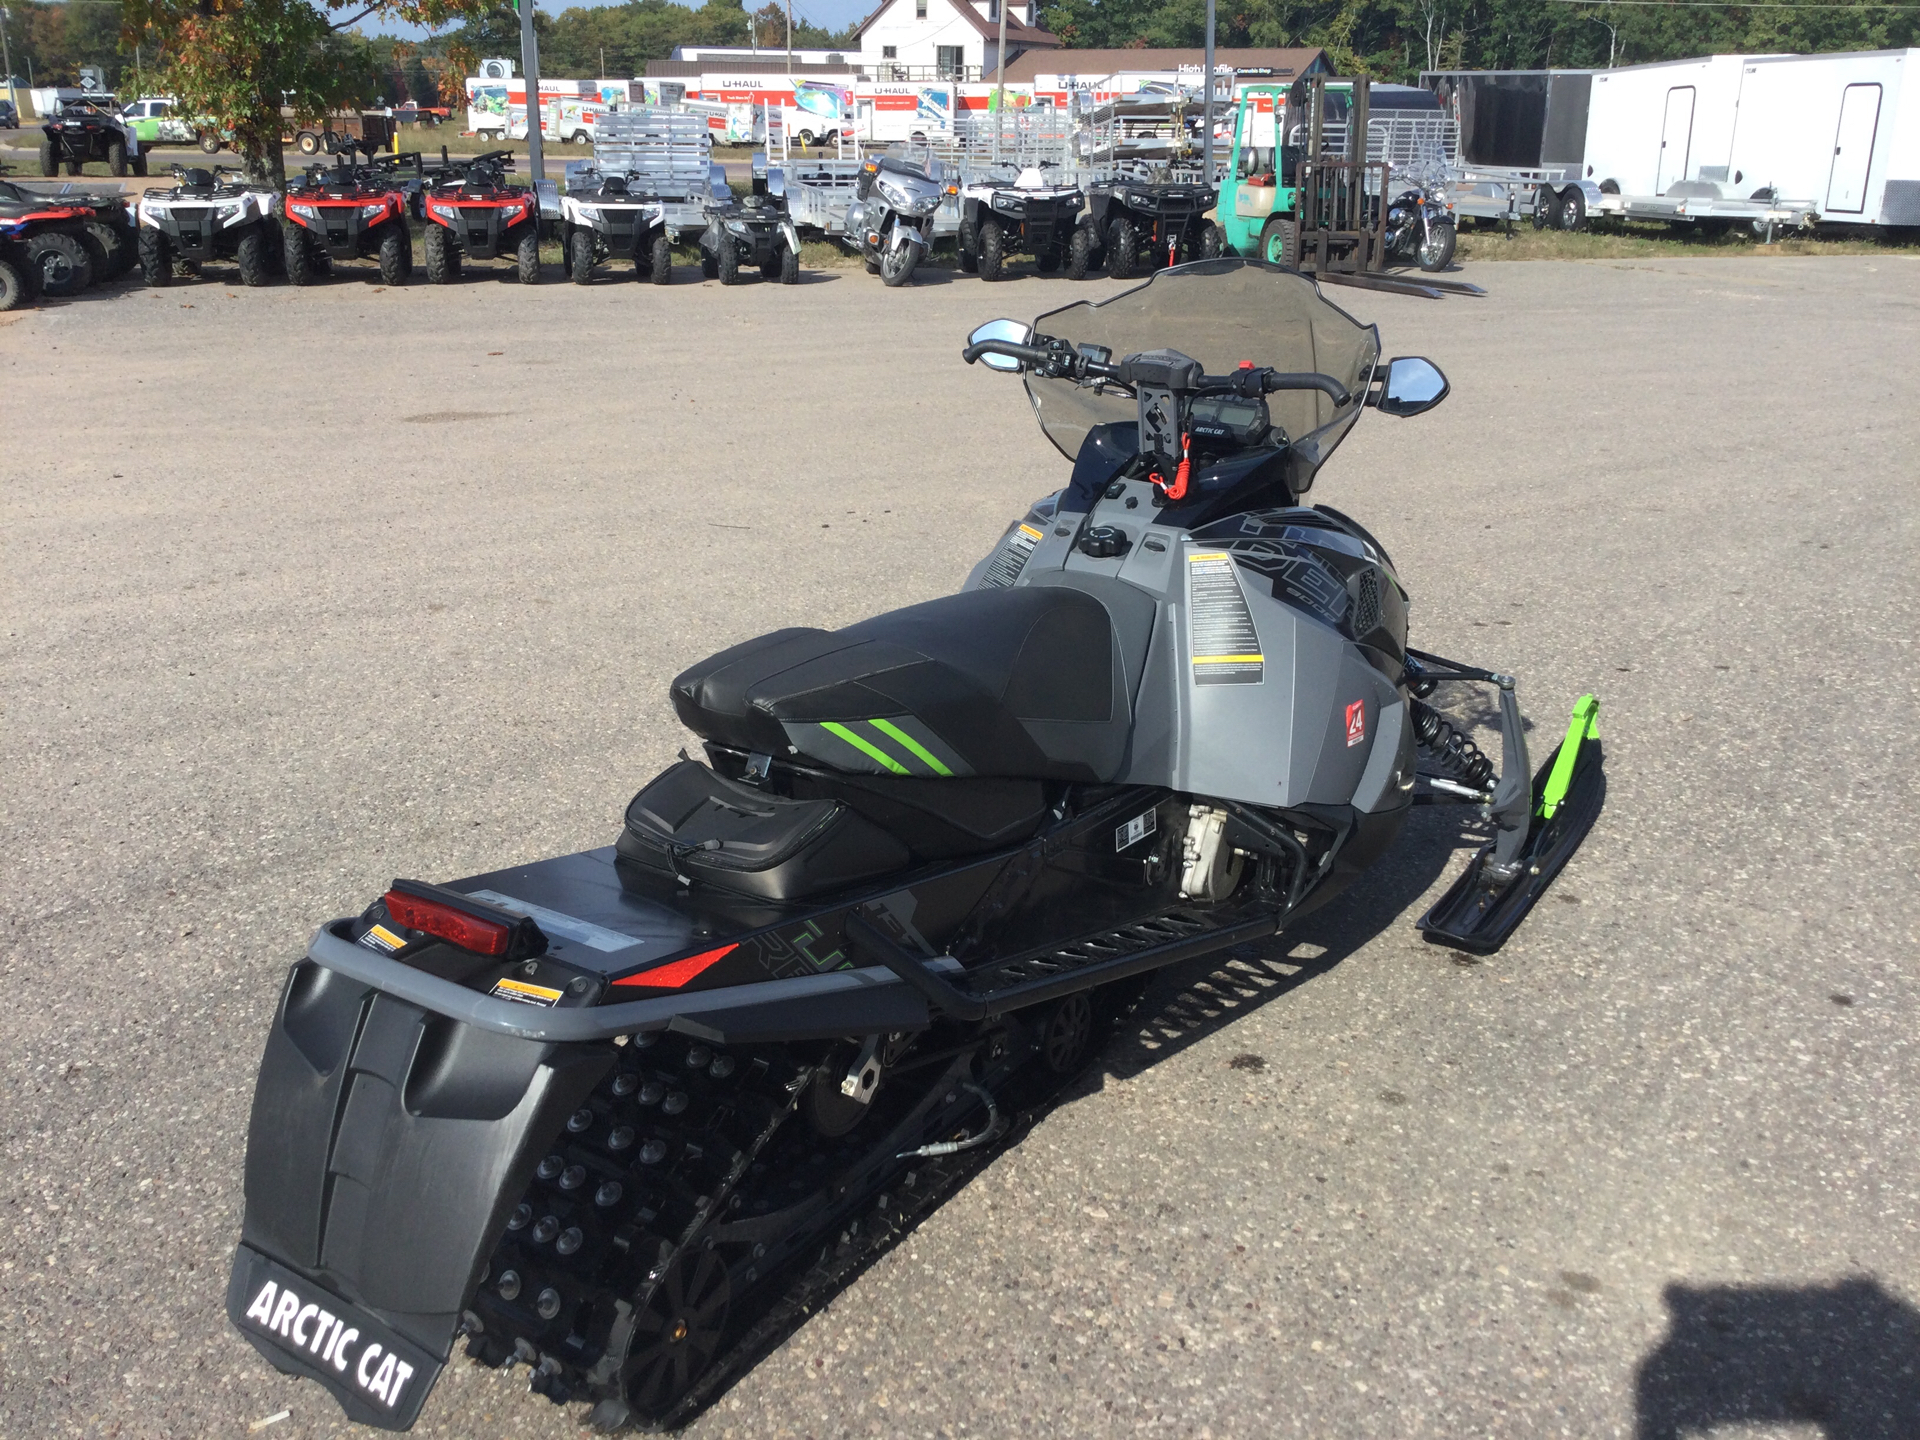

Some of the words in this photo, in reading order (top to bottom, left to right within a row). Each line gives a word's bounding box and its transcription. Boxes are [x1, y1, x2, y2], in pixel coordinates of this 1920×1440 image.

[1178, 64, 1201, 73] High
[722, 80, 763, 88] U-HAUL
[1195, 426, 1214, 434] ARCTIC
[246, 1280, 360, 1371] ARCTIC
[358, 1343, 414, 1407] CAT
